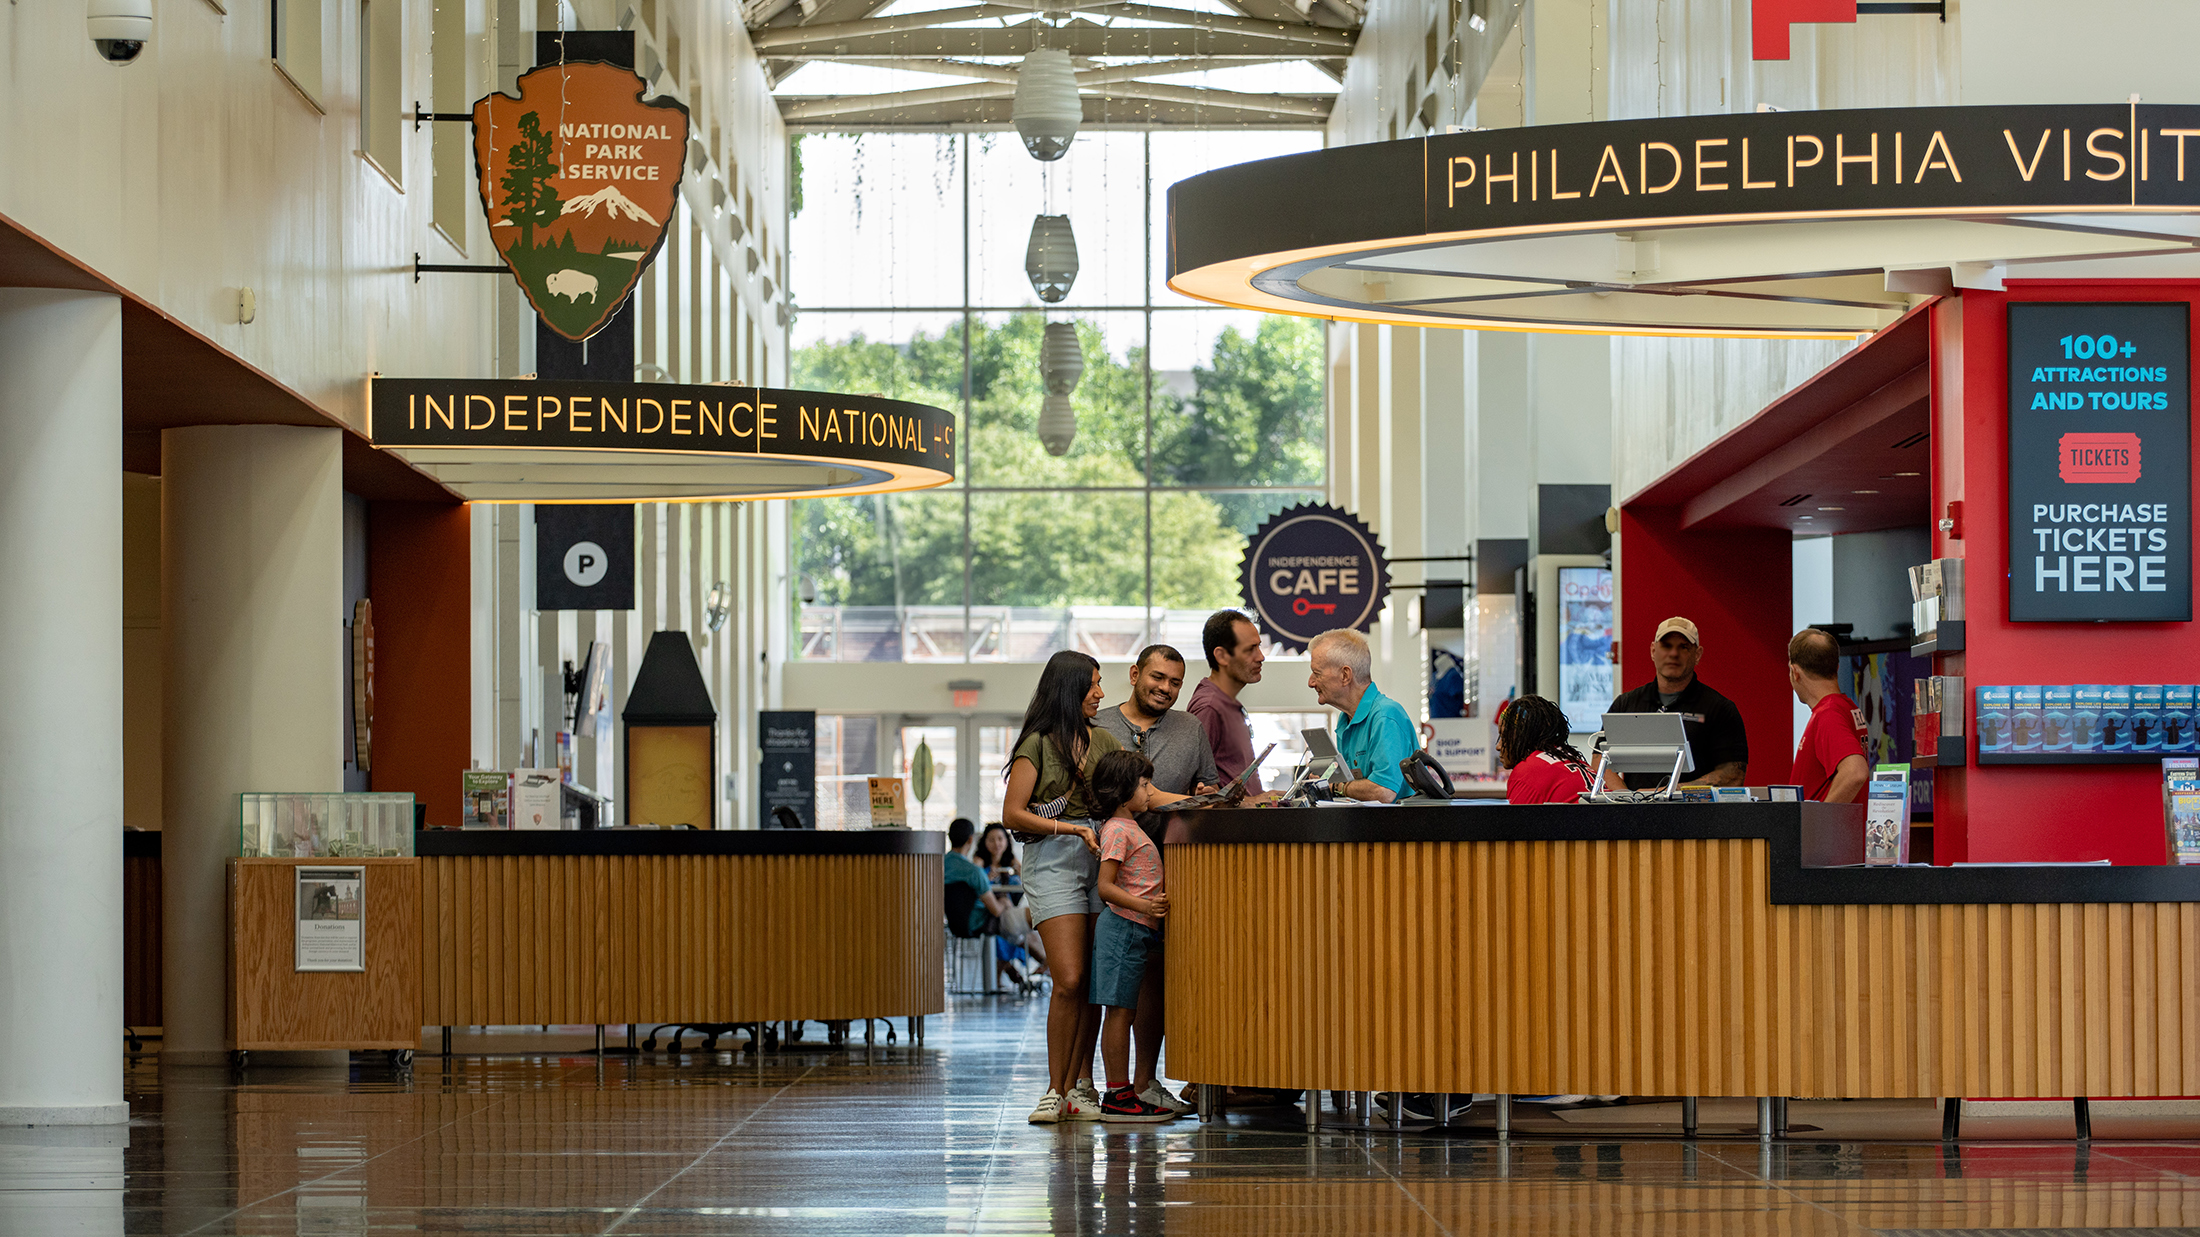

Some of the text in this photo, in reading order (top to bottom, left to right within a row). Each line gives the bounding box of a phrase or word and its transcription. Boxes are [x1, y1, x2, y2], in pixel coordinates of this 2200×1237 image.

[559, 123, 672, 140] NATIONAL
[585, 144, 644, 160] PARK
[568, 164, 660, 180] SERVICE
[1448, 129, 1963, 208] PHILADELPHIA
[2060, 334, 2137, 360] 100+
[2031, 367, 2168, 382] ATTRACTIONS
[2030, 392, 2168, 410] AND TOURS
[408, 393, 778, 440] INDEPENDENCE
[799, 404, 928, 454] NATIONAL
[2070, 448, 2130, 466] TICKETS
[2033, 504, 2168, 523] PURCHASE
[2033, 528, 2168, 552] TICKETS
[578, 554, 595, 574] P
[1268, 556, 1360, 568] INDEPENDENCE
[1269, 568, 1360, 596] CAFE
[2035, 556, 2167, 592] HERE
[1436, 739, 1462, 748] SHOP
[1445, 748, 1486, 757] SUPPORT
[872, 796, 893, 804] HERE
[1913, 780, 1930, 804] FOR
